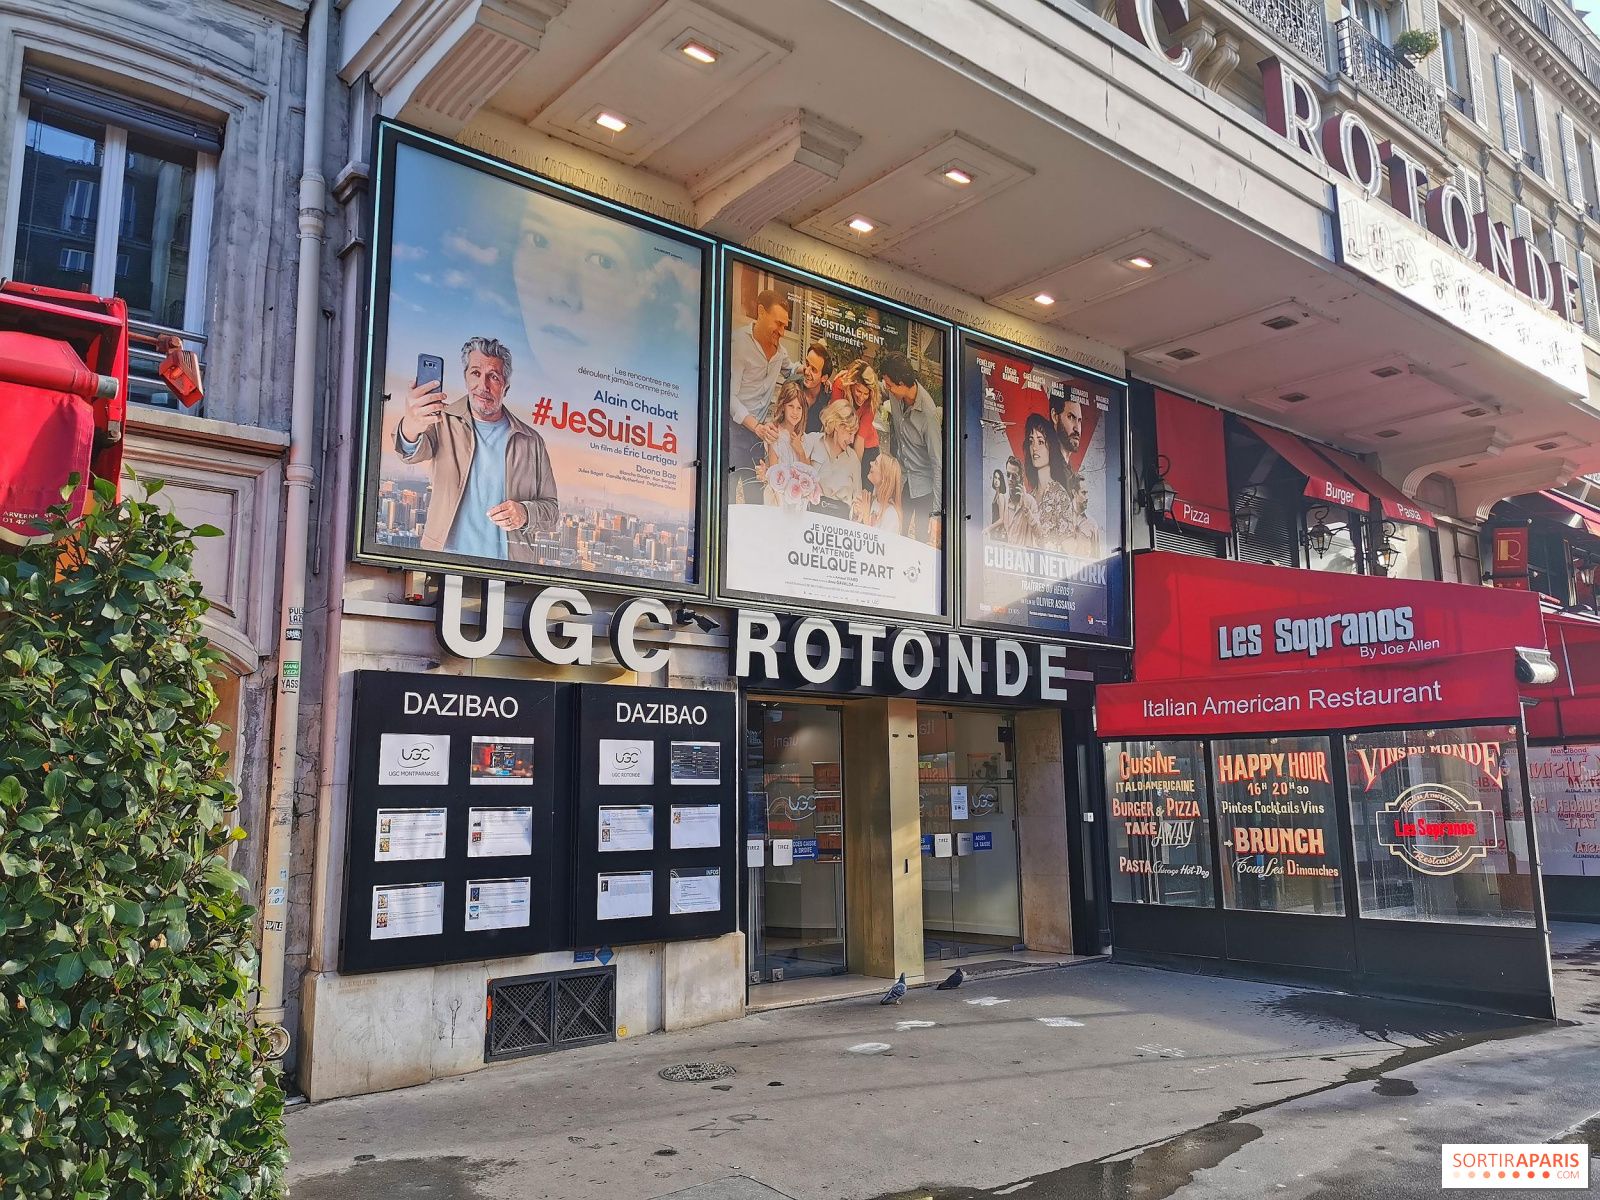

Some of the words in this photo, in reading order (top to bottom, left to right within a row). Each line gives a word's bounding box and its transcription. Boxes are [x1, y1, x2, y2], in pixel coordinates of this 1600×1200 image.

[1276, 58, 1584, 330] ROTONDE
[577, 366, 611, 381] déroulent
[610, 374, 634, 387] jamais
[634, 381, 660, 393] comme
[660, 386, 680, 399] prévu.
[614, 367, 627, 376] Les
[627, 371, 662, 386] rencontres
[662, 381, 672, 389] ne
[593, 390, 628, 409] Alain
[630, 398, 679, 421] Chabat
[531, 396, 678, 455] #JeSuisLà
[590, 442, 600, 451] Un
[600, 443, 614, 453] film
[613, 446, 623, 454] de
[623, 443, 640, 458] Éric
[641, 451, 678, 468] Lartigau
[635, 464, 661, 477] Doona
[661, 469, 677, 480] Bae
[1325, 481, 1355, 506] Burger
[1183, 504, 1210, 525] Pizza
[1396, 503, 1422, 521] Pasta
[803, 529, 885, 556] QUELQU'UN
[810, 523, 820, 532] JE
[821, 525, 862, 539] VOUDRAIS
[863, 533, 879, 542] QUE
[787, 550, 857, 575] QUELQUE
[860, 561, 895, 580] PART
[984, 545, 1035, 574] CUBAN
[1039, 555, 1108, 585] NETWORK
[438, 574, 674, 673] UGC
[734, 608, 1069, 701] ROTONDE
[1218, 623, 1262, 660] Les
[1274, 605, 1415, 657] Sopranos
[1359, 645, 1376, 659] By
[1380, 642, 1405, 657] Joe
[1407, 637, 1441, 652] Allen
[403, 691, 519, 719] DAZIBAO
[1142, 698, 1198, 718] Italian
[1201, 693, 1301, 716] American
[1308, 680, 1443, 709] Restaurant
[616, 702, 708, 725] DAZIBAO
[401, 747, 431, 761] UGC
[615, 752, 639, 764] UGC
[1217, 752, 1286, 785] HAPPY
[1287, 751, 1331, 785] HOUR
[1355, 746, 1407, 793] VINS
[1407, 745, 1426, 756] DU
[1429, 741, 1504, 791] MONDE
[788, 795, 817, 811] UGC
[1112, 798, 1154, 818] BURGER
[1155, 804, 1164, 817] &
[1165, 797, 1201, 819] PIZZA
[1221, 800, 1253, 814] Pintes
[1254, 801, 1300, 815] Cocktails
[1299, 799, 1325, 814] Vins
[1124, 821, 1158, 836] TAKE
[1151, 819, 1195, 849] AWAY
[1232, 827, 1326, 856] BRUNCH
[1394, 819, 1417, 837] Les
[1417, 817, 1476, 842] Sopranos
[1119, 855, 1153, 875] PASTA
[1232, 855, 1265, 876] Tous
[1259, 856, 1284, 880] Les
[1286, 859, 1340, 878] Dimanches
[1413, 848, 1463, 865] Restaurant
